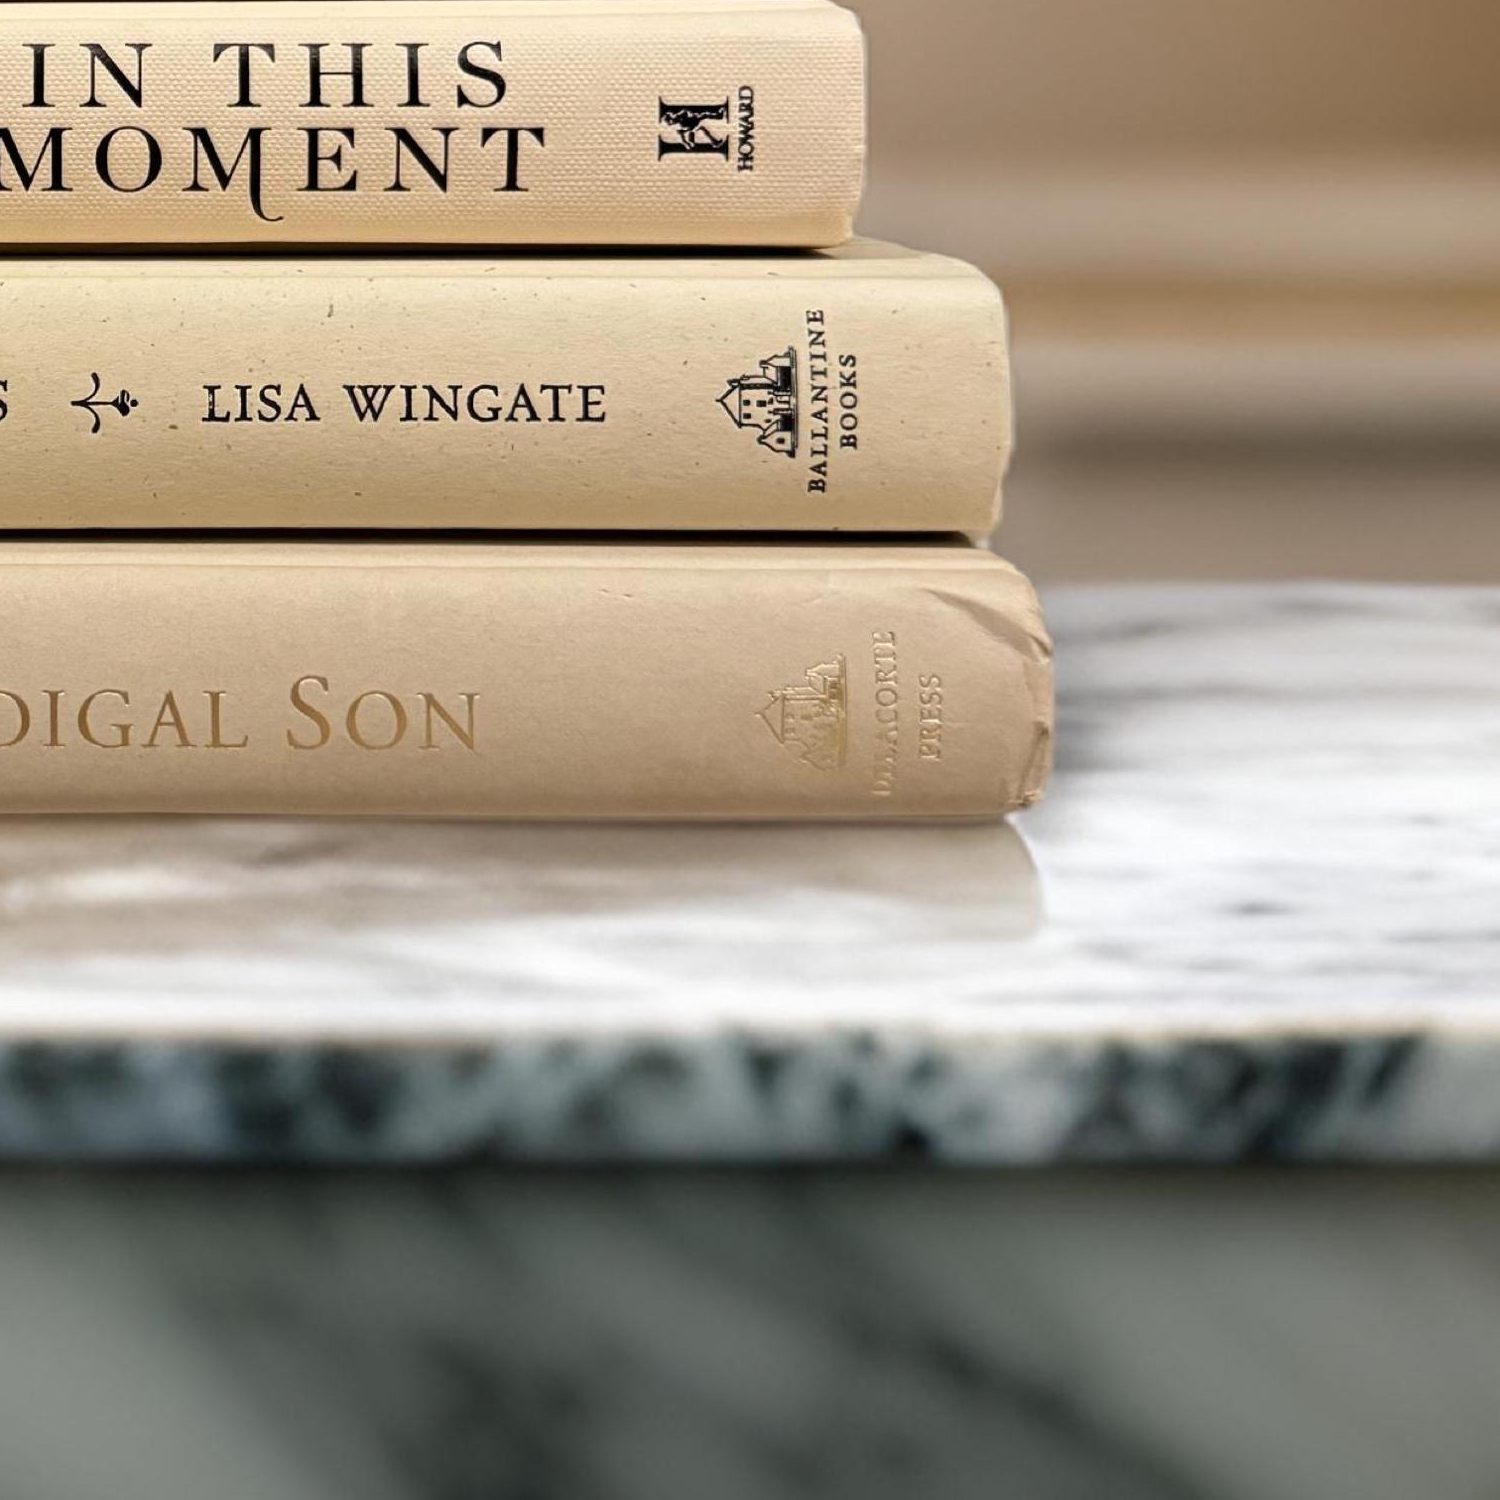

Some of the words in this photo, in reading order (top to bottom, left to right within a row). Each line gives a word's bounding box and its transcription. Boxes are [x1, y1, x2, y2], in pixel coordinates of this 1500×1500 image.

[18, 42, 153, 109] IN
[212, 40, 508, 109] THIS
[737, 85, 754, 172] HOWARD
[201, 382, 322, 424] LISA
[341, 382, 607, 424] WINGATE
[805, 309, 829, 494] BALLANTINE
[838, 354, 859, 450] BOOKS
[286, 668, 481, 750] SON
[918, 673, 943, 762] PRESS
